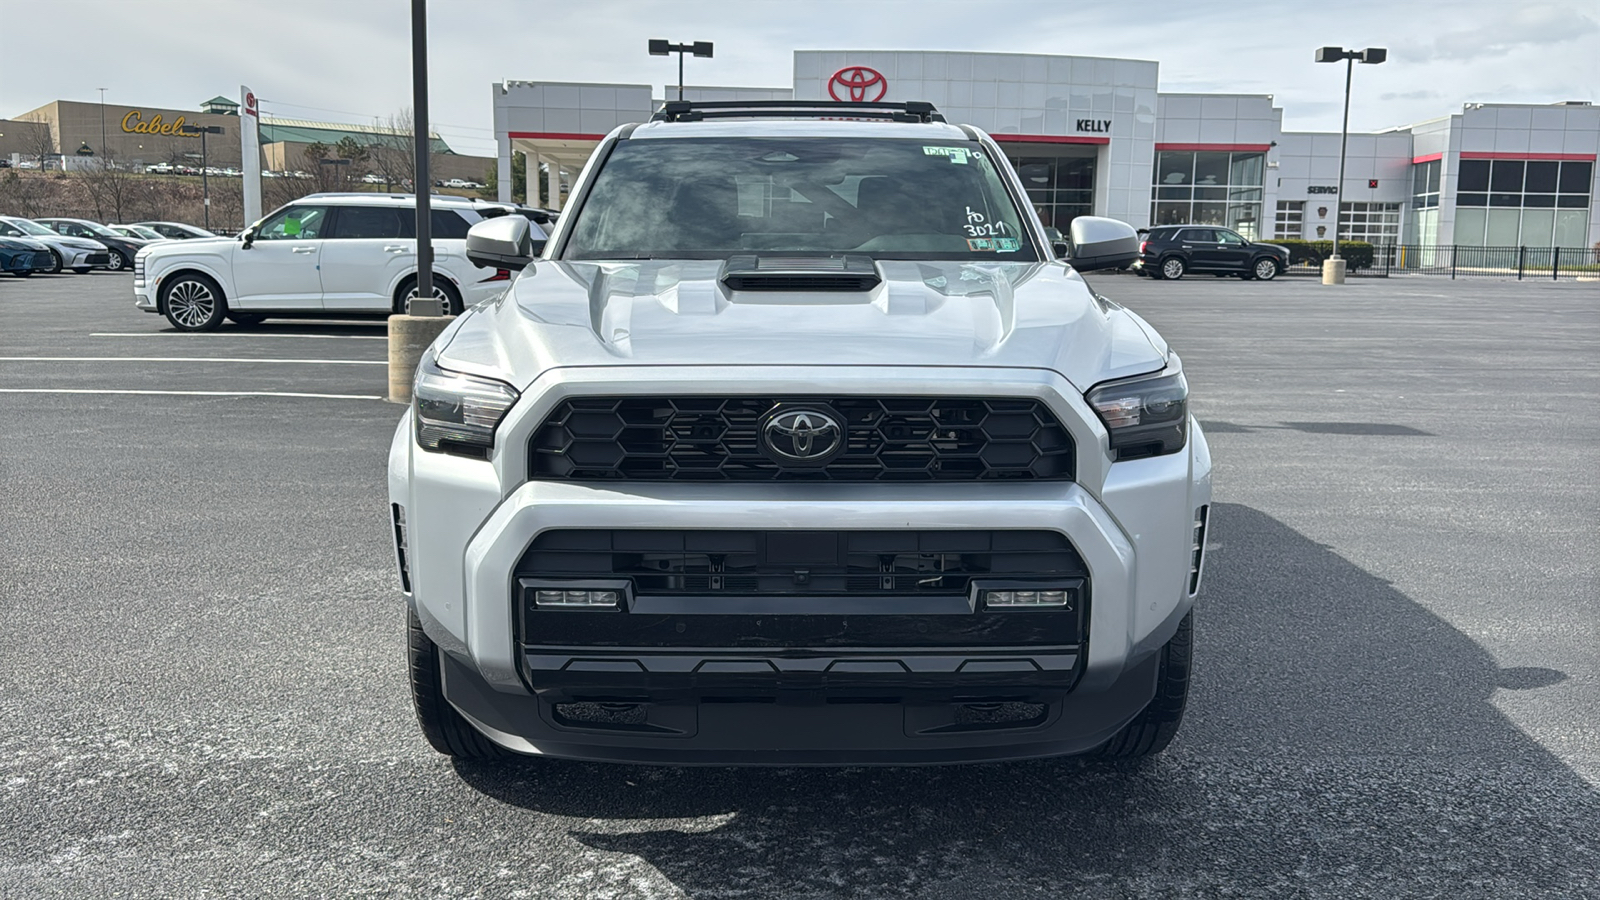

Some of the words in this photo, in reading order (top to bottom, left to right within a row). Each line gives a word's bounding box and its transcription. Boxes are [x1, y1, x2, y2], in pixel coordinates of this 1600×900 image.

[121, 110, 200, 137] Cabel
[1076, 119, 1111, 132] KELLY
[1307, 186, 1338, 194] SERVIC
